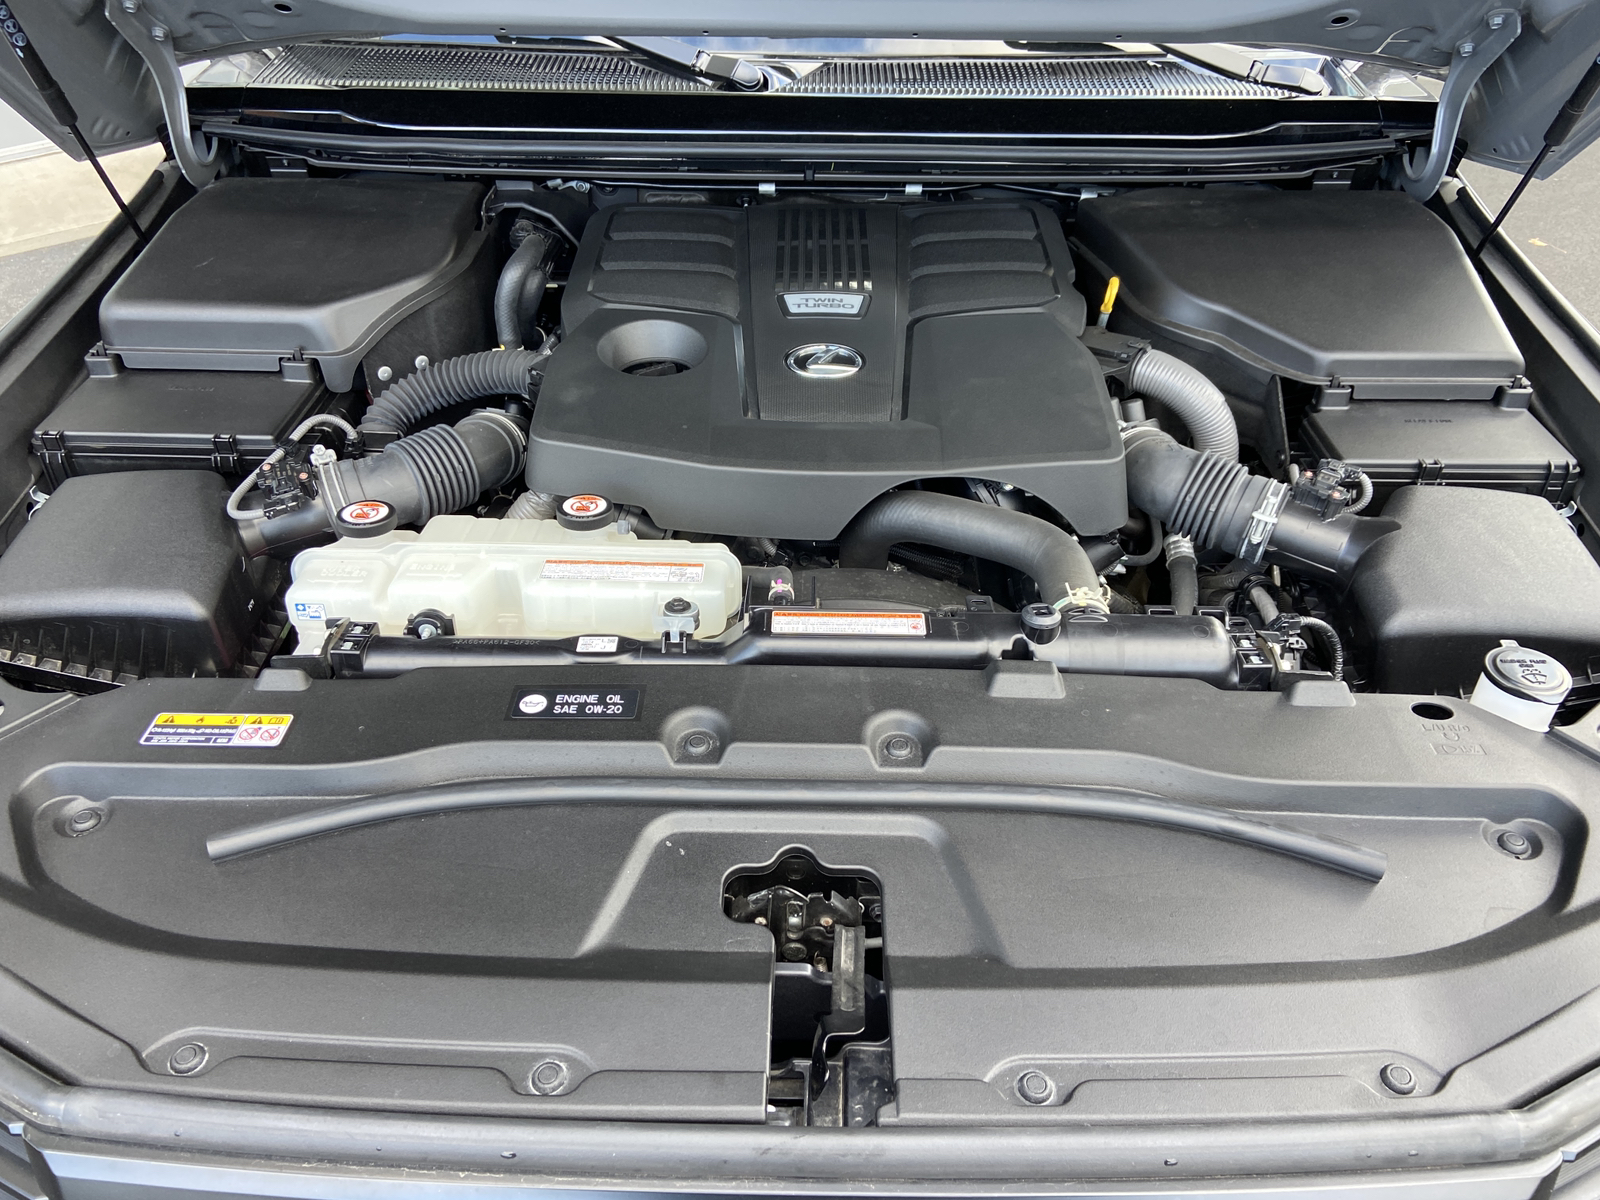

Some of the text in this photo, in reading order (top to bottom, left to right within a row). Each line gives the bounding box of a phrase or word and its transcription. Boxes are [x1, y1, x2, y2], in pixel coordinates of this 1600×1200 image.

[555, 694, 625, 704] ENGINE OIL
[553, 704, 579, 714] SAE
